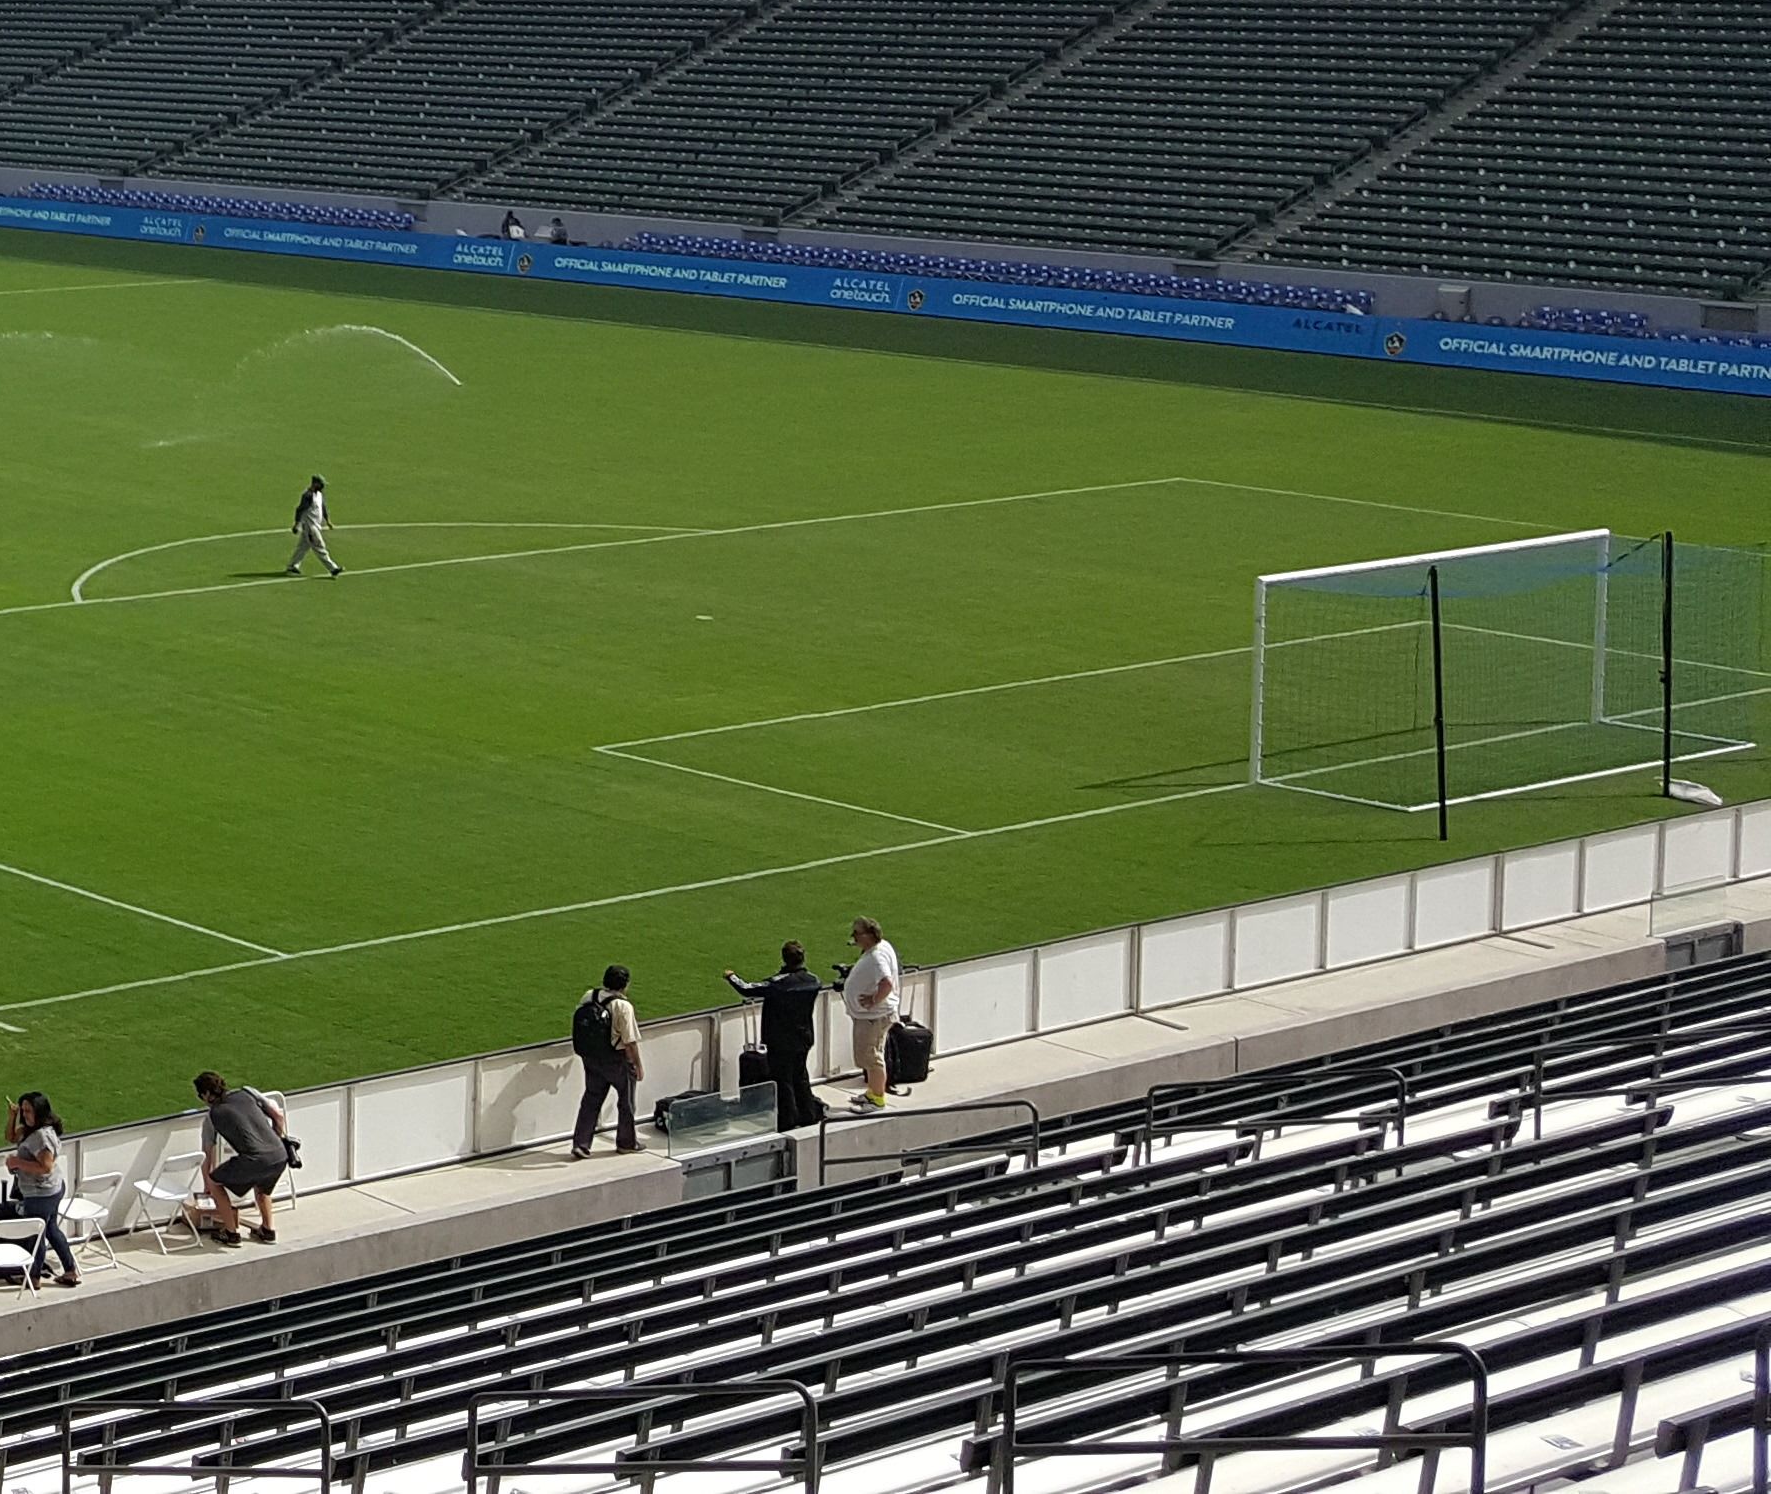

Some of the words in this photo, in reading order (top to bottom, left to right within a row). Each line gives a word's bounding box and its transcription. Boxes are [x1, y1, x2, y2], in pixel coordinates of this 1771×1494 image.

[455, 243, 504, 256] ALCATEL
[554, 257, 600, 271] OFFICIAL
[601, 261, 672, 278] SMARTPHONE
[673, 267, 697, 280] AND
[699, 270, 736, 283] TABLET
[737, 273, 787, 288] PARTNER
[833, 278, 890, 292] ALCATEL
[830, 288, 890, 304] onetouch
[952, 293, 1007, 310] OFFICIAL
[1008, 297, 1095, 317] SMARTPHONE
[1096, 305, 1126, 320] AND
[1127, 308, 1173, 324] TABLET
[1173, 311, 1235, 330] PARTNER
[1292, 317, 1362, 334] ALCATEL
[1439, 337, 1507, 356] OFFICIAL
[1509, 343, 1618, 367] SMARTPHONE
[1619, 354, 1657, 370] AND
[1659, 357, 1717, 375] TABLET
